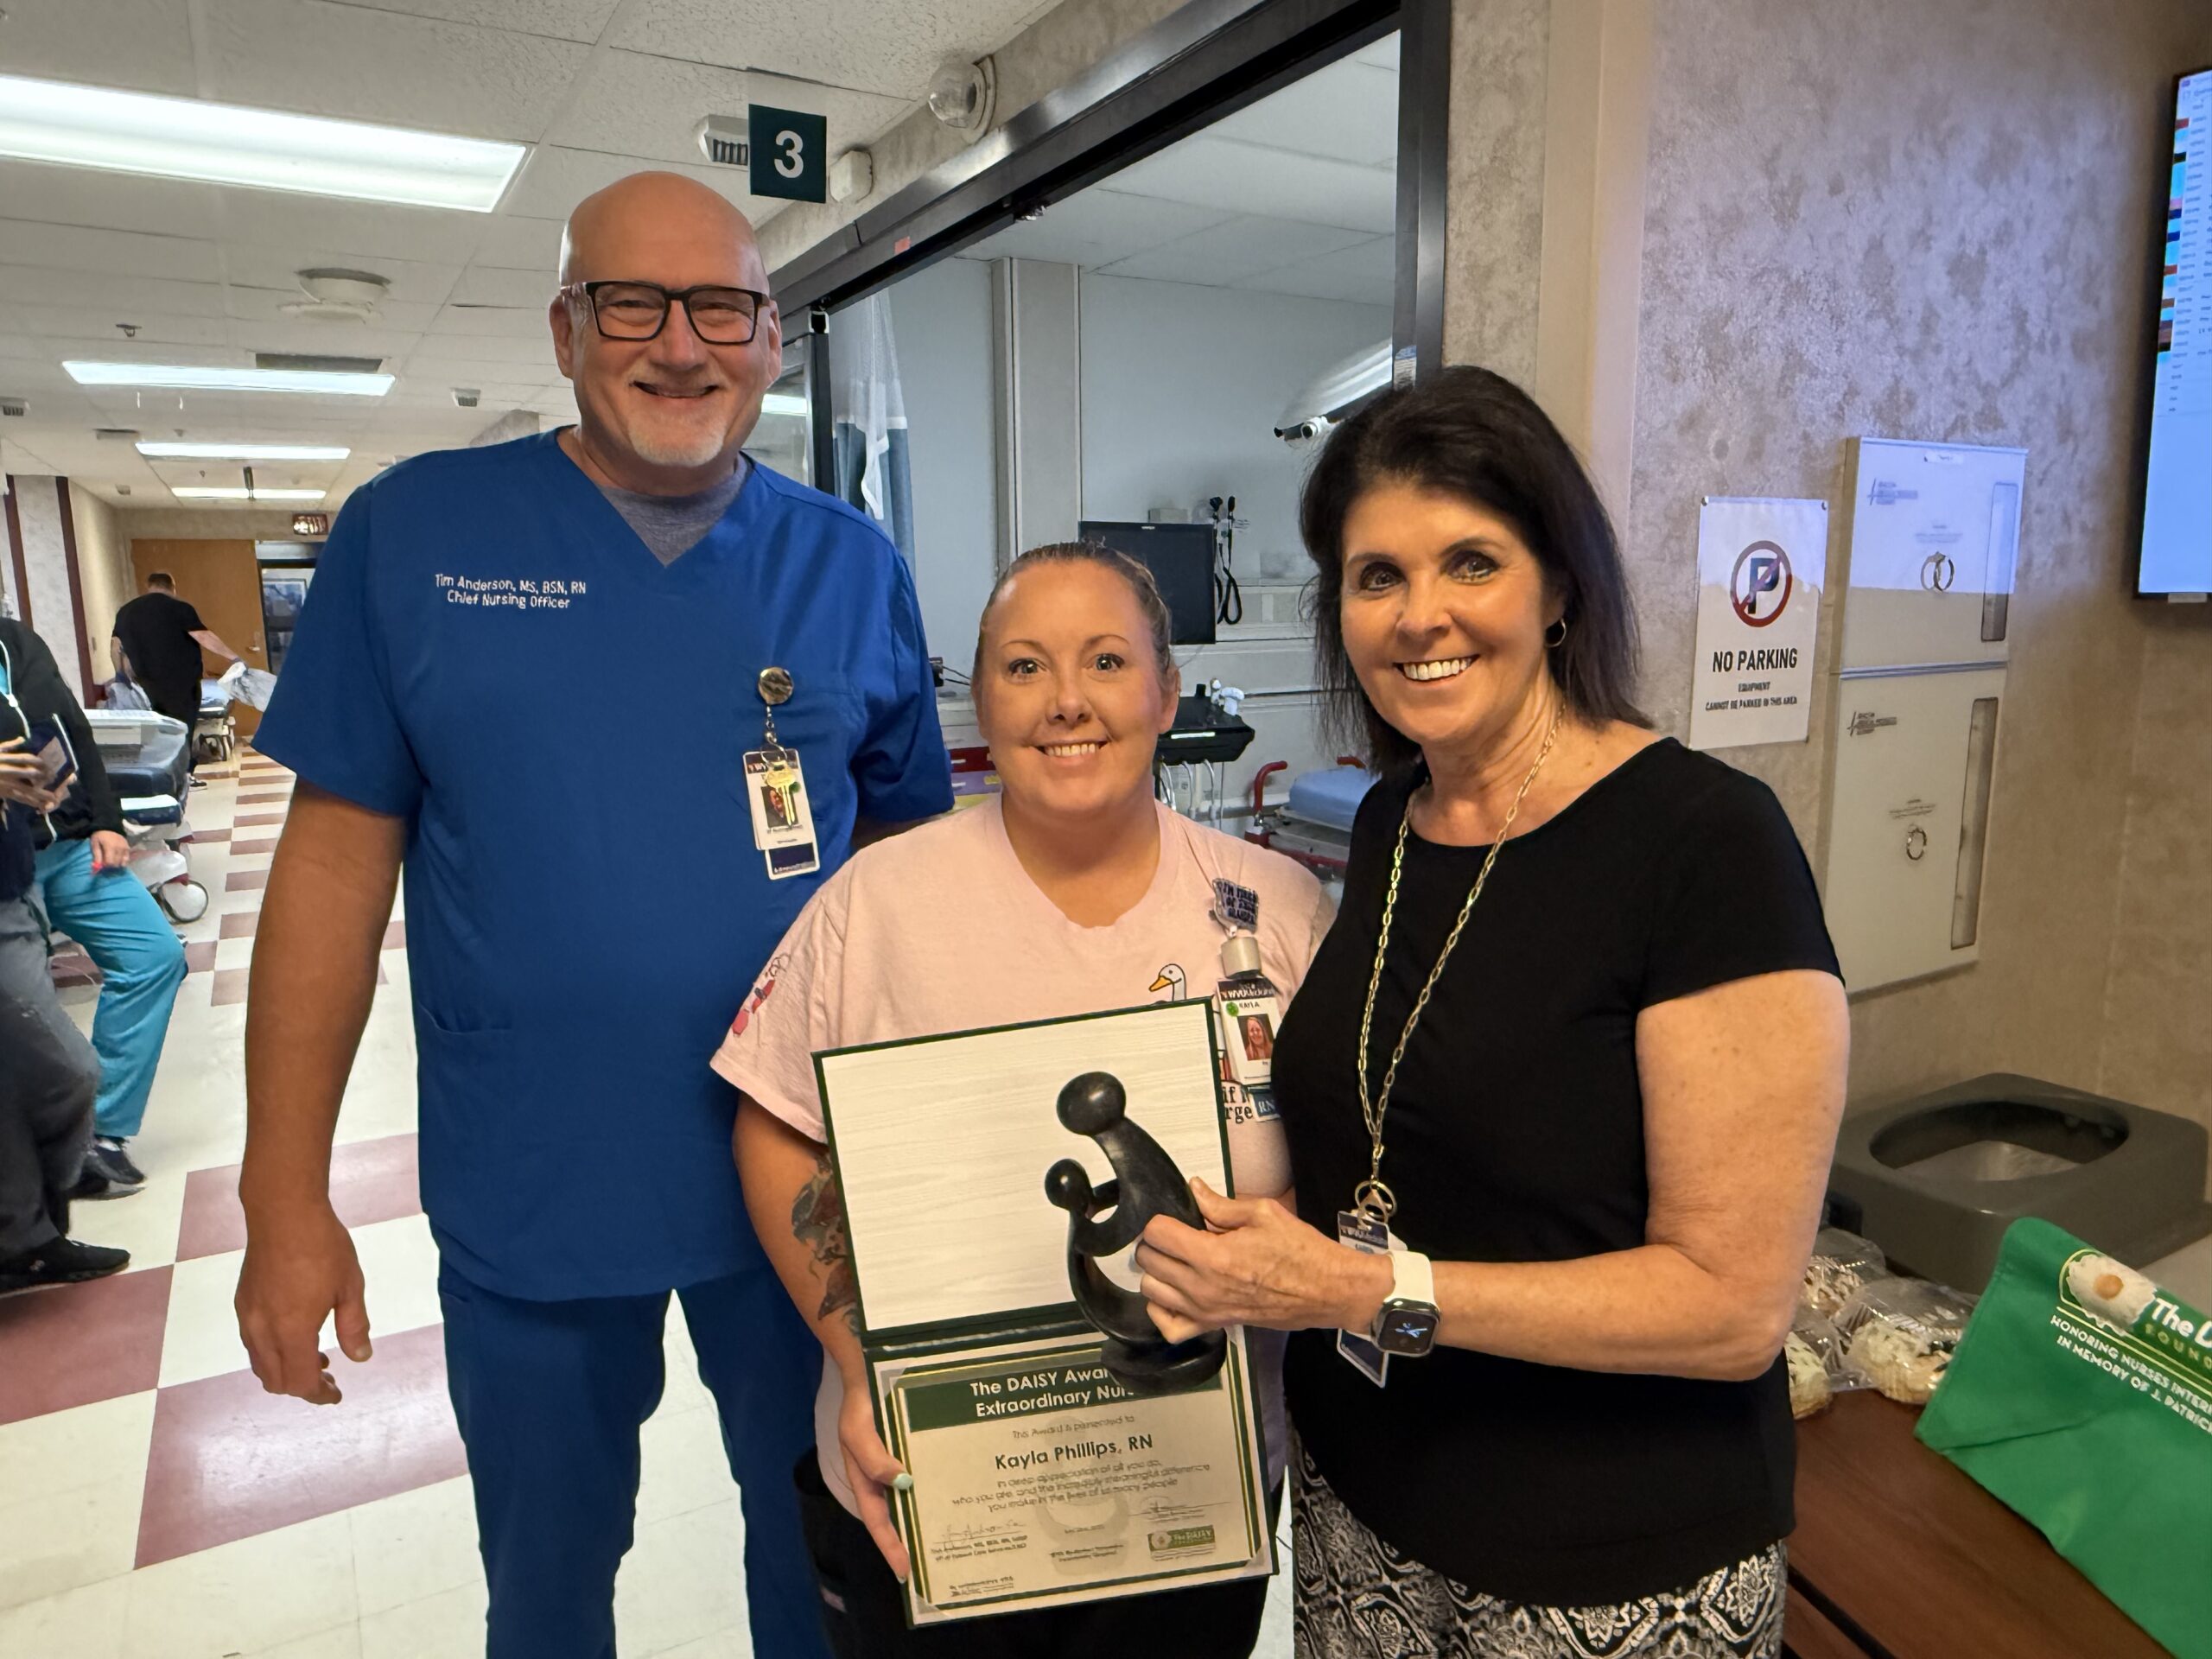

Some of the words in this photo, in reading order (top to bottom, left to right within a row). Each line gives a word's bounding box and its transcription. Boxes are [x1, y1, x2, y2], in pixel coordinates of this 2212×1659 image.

[773, 130, 804, 178] 3
[435, 573, 454, 588] Tim
[457, 575, 516, 592] Anderson,
[520, 580, 539, 594] MS,
[543, 582, 568, 595] BSN,
[571, 582, 587, 594] RN
[448, 589, 478, 605] Chief
[482, 594, 526, 609] Nursing
[530, 595, 570, 608] Officer
[1713, 651, 1733, 672] NO
[1738, 647, 1797, 671] PARKING
[1225, 1107, 1253, 1124] rge
[2152, 1298, 2195, 1338] The
[2050, 1315, 2119, 1360] HONORING
[2120, 1354, 2171, 1388] NURSES
[2056, 1335, 2072, 1349] IN
[2073, 1344, 2130, 1381] MEMORY
[2131, 1376, 2151, 1391] OF
[970, 1382, 1001, 1396] The
[1007, 1371, 1058, 1392] DAISY
[1065, 1368, 1109, 1383] Awar
[976, 1390, 1091, 1417] Extraordinary
[995, 1451, 1049, 1470] Kayla
[1054, 1441, 1122, 1461] Phillips,
[1128, 1433, 1154, 1451] RN
